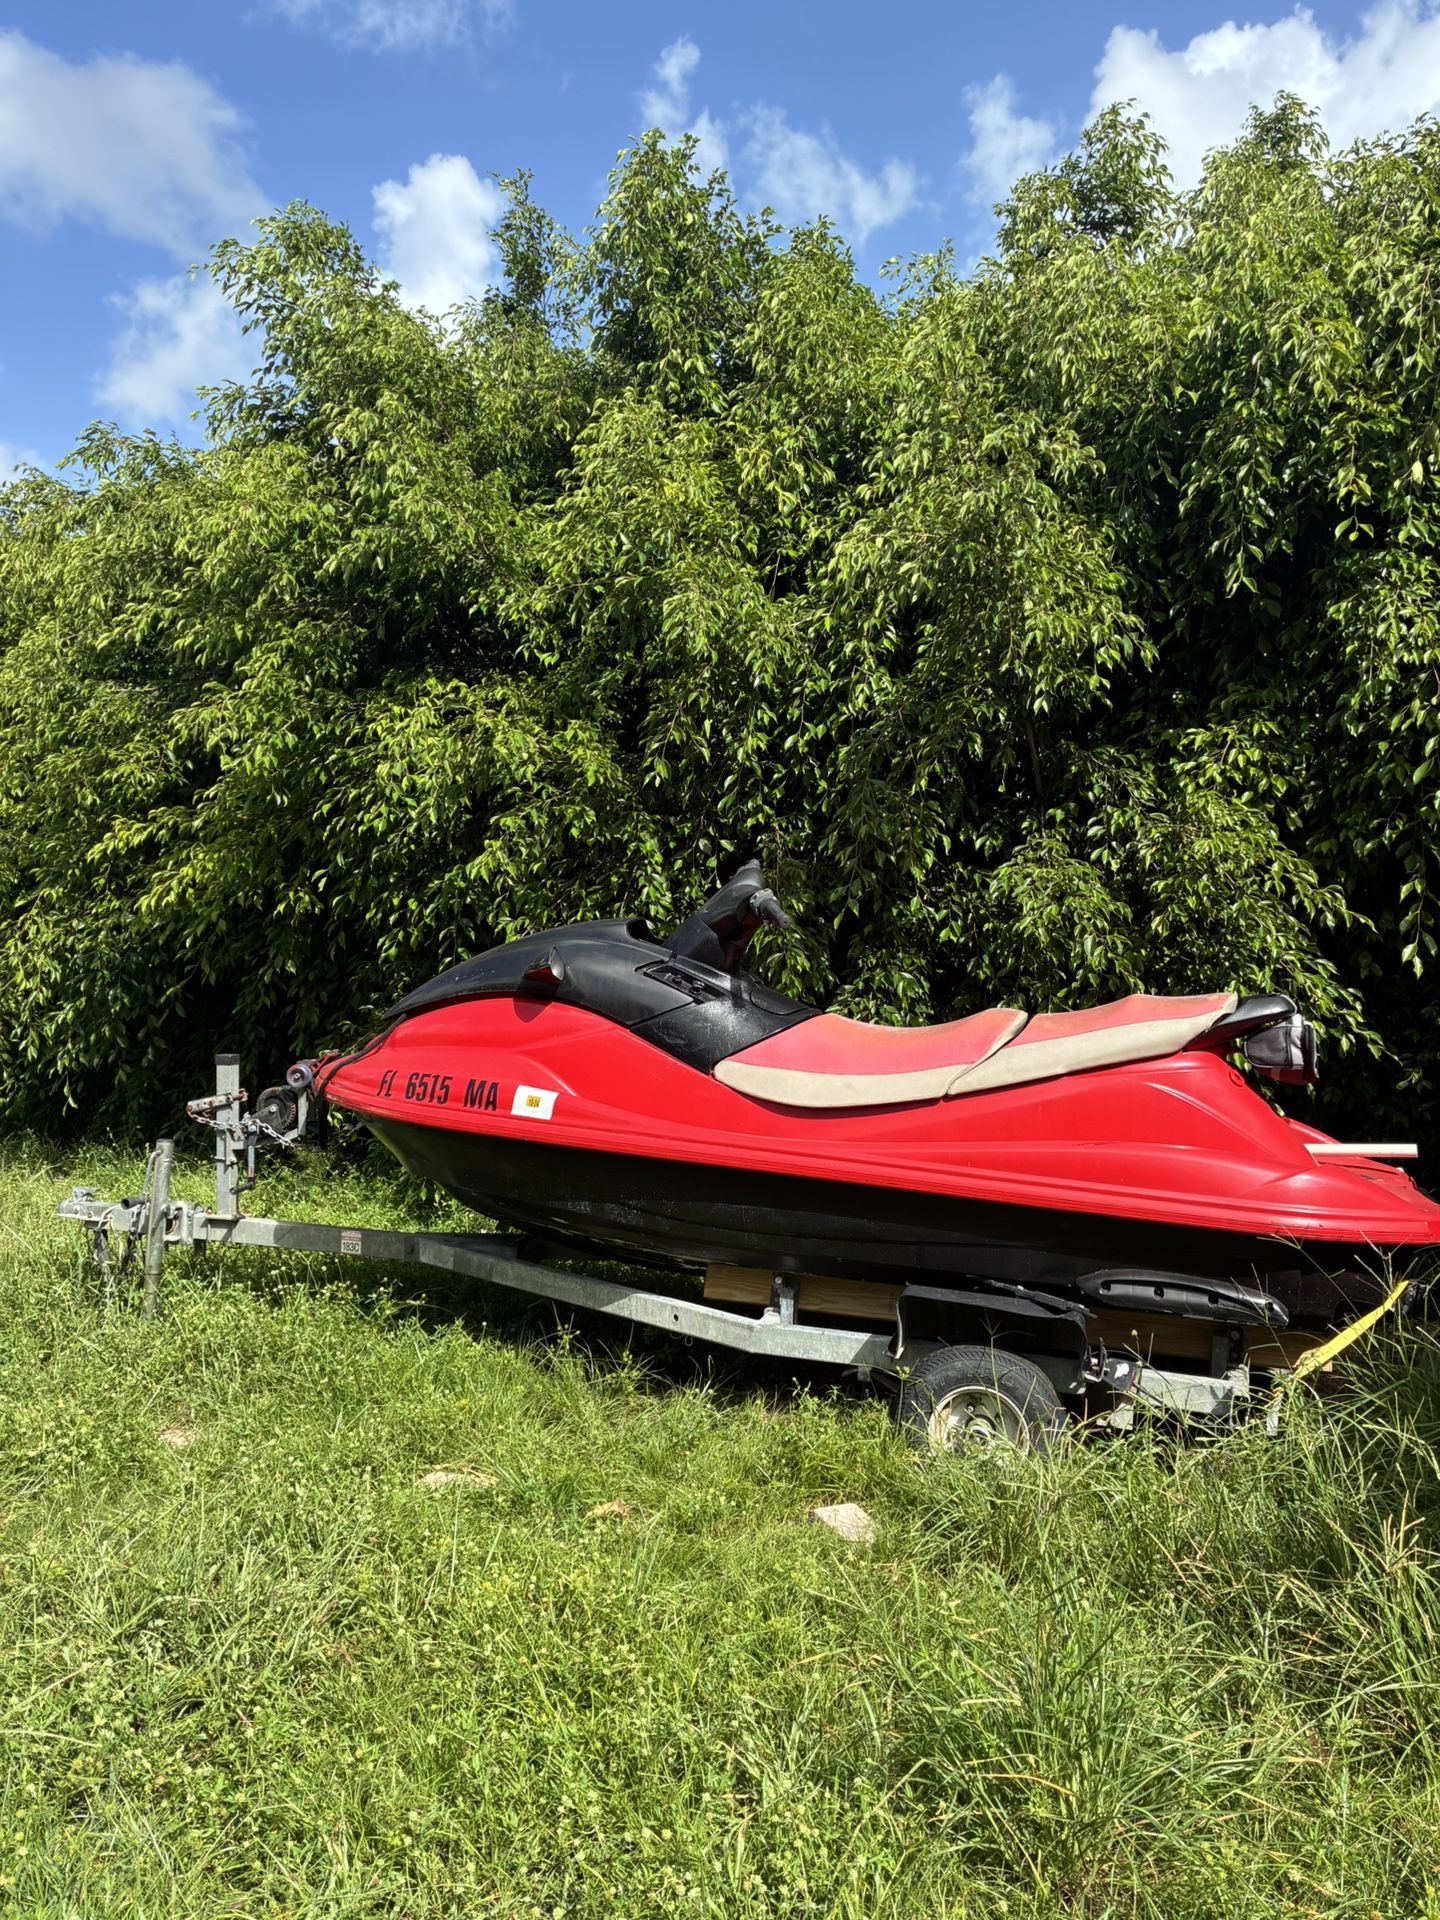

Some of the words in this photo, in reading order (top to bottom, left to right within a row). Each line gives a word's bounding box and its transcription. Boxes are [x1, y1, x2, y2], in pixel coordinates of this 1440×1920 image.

[377, 1070, 398, 1097] FL
[404, 1072, 453, 1105] 6515
[463, 1079, 499, 1111] MA
